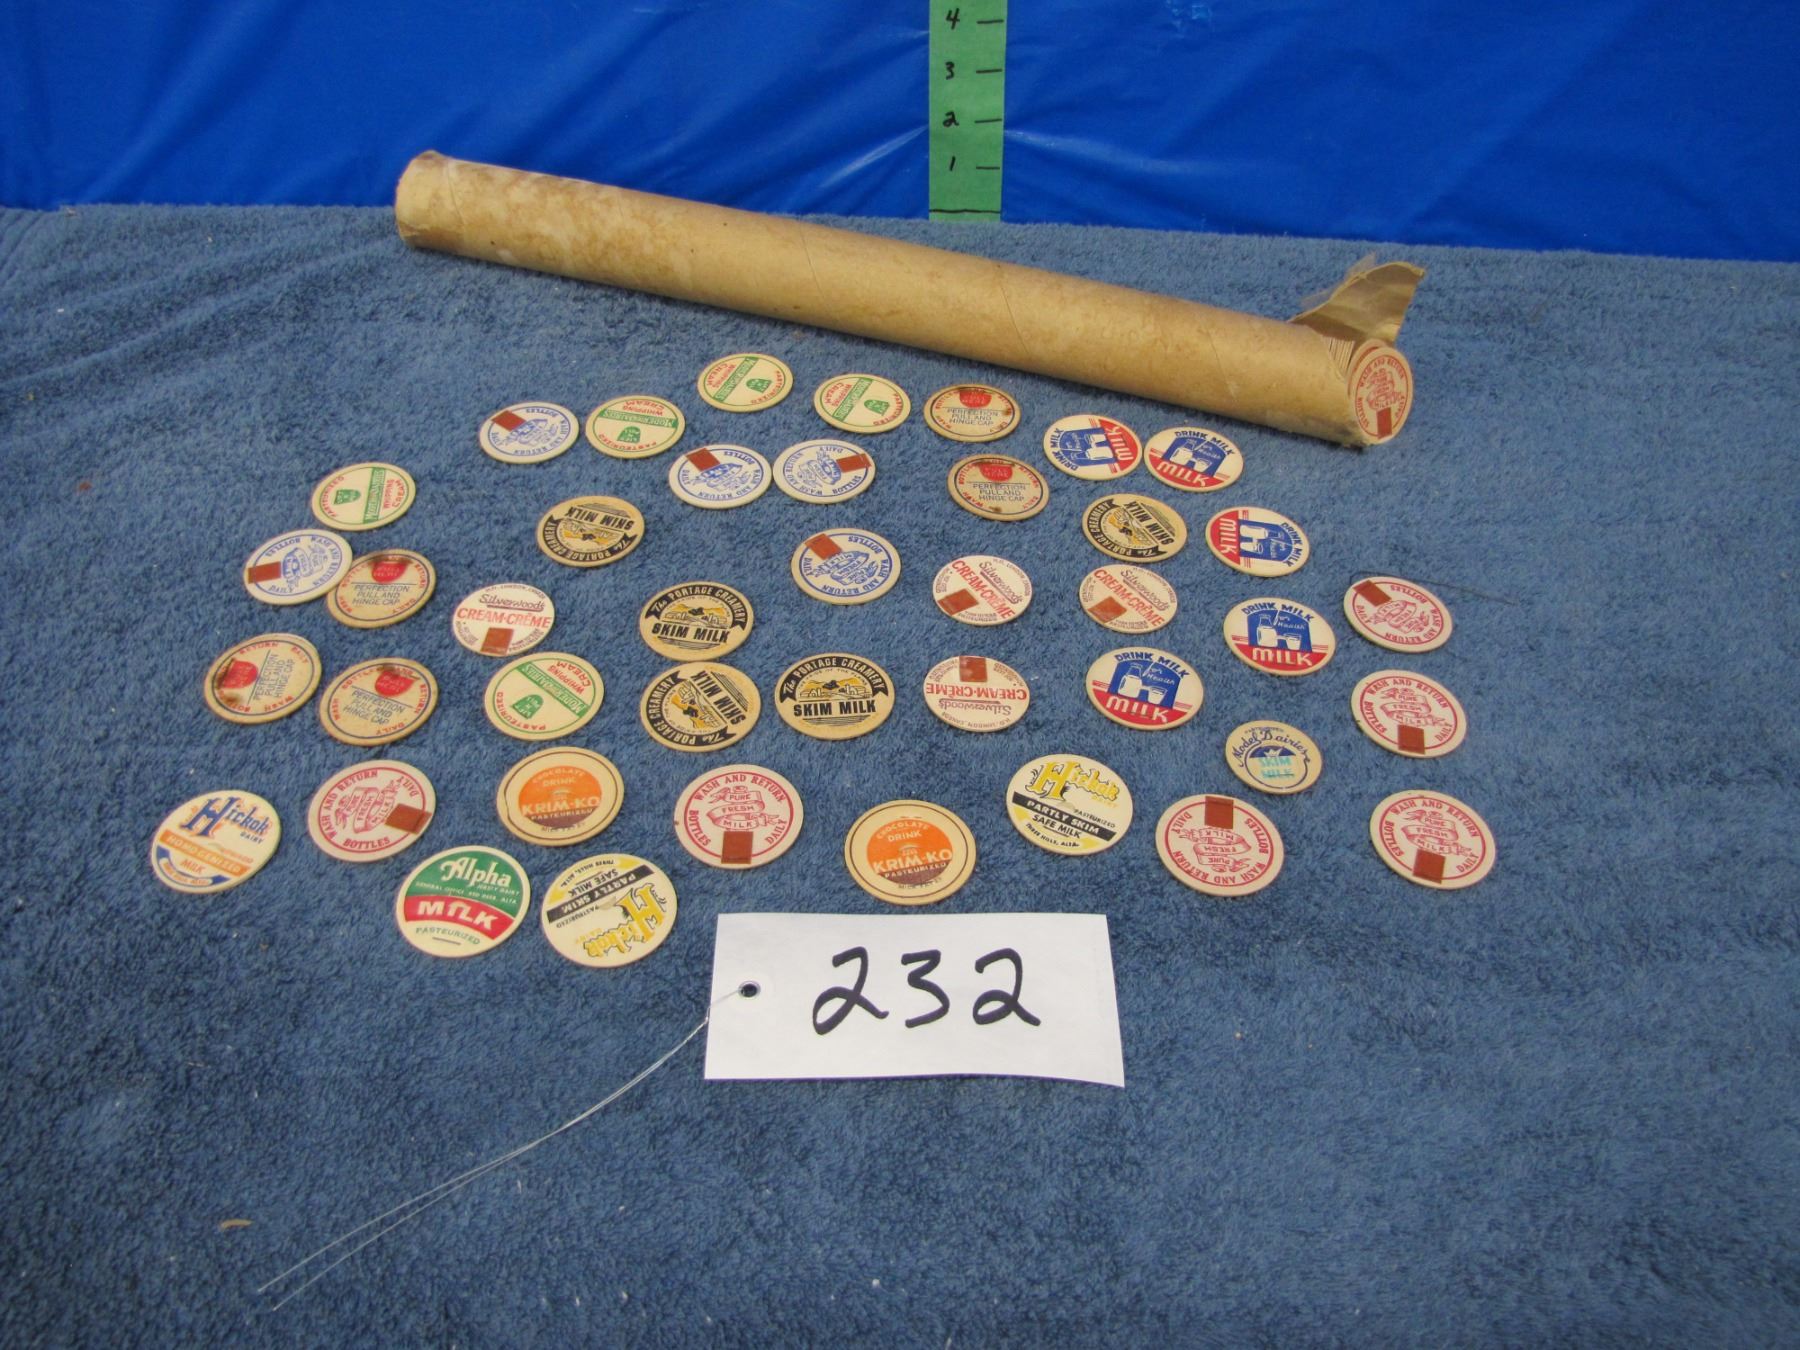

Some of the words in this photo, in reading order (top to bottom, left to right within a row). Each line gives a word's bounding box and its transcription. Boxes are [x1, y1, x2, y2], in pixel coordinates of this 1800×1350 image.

[946, 8, 960, 30] 4
[945, 62, 955, 80] 3
[943, 111, 959, 127] 2
[949, 156, 956, 171] 1
[1156, 460, 1205, 486] MILK
[565, 506, 599, 522] MILK
[600, 515, 634, 530] SKIM
[1124, 500, 1152, 522] MILK
[1146, 522, 1174, 545] SKIM
[1219, 517, 1236, 554] MILK
[669, 586, 711, 600] PORTAGE
[1241, 602, 1276, 615] DRINK
[1280, 603, 1314, 621] MILK
[651, 622, 688, 638] SKIM
[693, 627, 730, 643] MILK
[1114, 651, 1153, 661] DRINK
[1157, 655, 1190, 678] MILK
[1252, 647, 1313, 666] MILK
[556, 660, 591, 687] CREAM
[690, 670, 720, 697] MILK
[795, 657, 837, 678] PORTAGE
[840, 658, 884, 690] CREAMERY
[713, 696, 746, 724] SKIM
[792, 702, 832, 716] SKIM
[839, 699, 876, 714] MILK
[1105, 694, 1168, 723] MILK
[653, 719, 695, 744] PORTAGE
[724, 773, 746, 784] AND
[750, 774, 785, 803] RETURN
[689, 810, 710, 846] BOTTLES
[1026, 800, 1067, 822] PARTLY
[1070, 816, 1100, 834] SKIM
[1031, 812, 1057, 828] SAFE
[1057, 822, 1081, 838] MILK
[887, 829, 922, 842] DRINK
[440, 857, 512, 888] Alpha
[594, 867, 619, 885] SAFE
[594, 871, 636, 898] PARTLY
[567, 882, 593, 897] MILK
[418, 901, 498, 930] MILK
[415, 927, 481, 945] PASTEURIZED
[812, 946, 1041, 1035] 232
